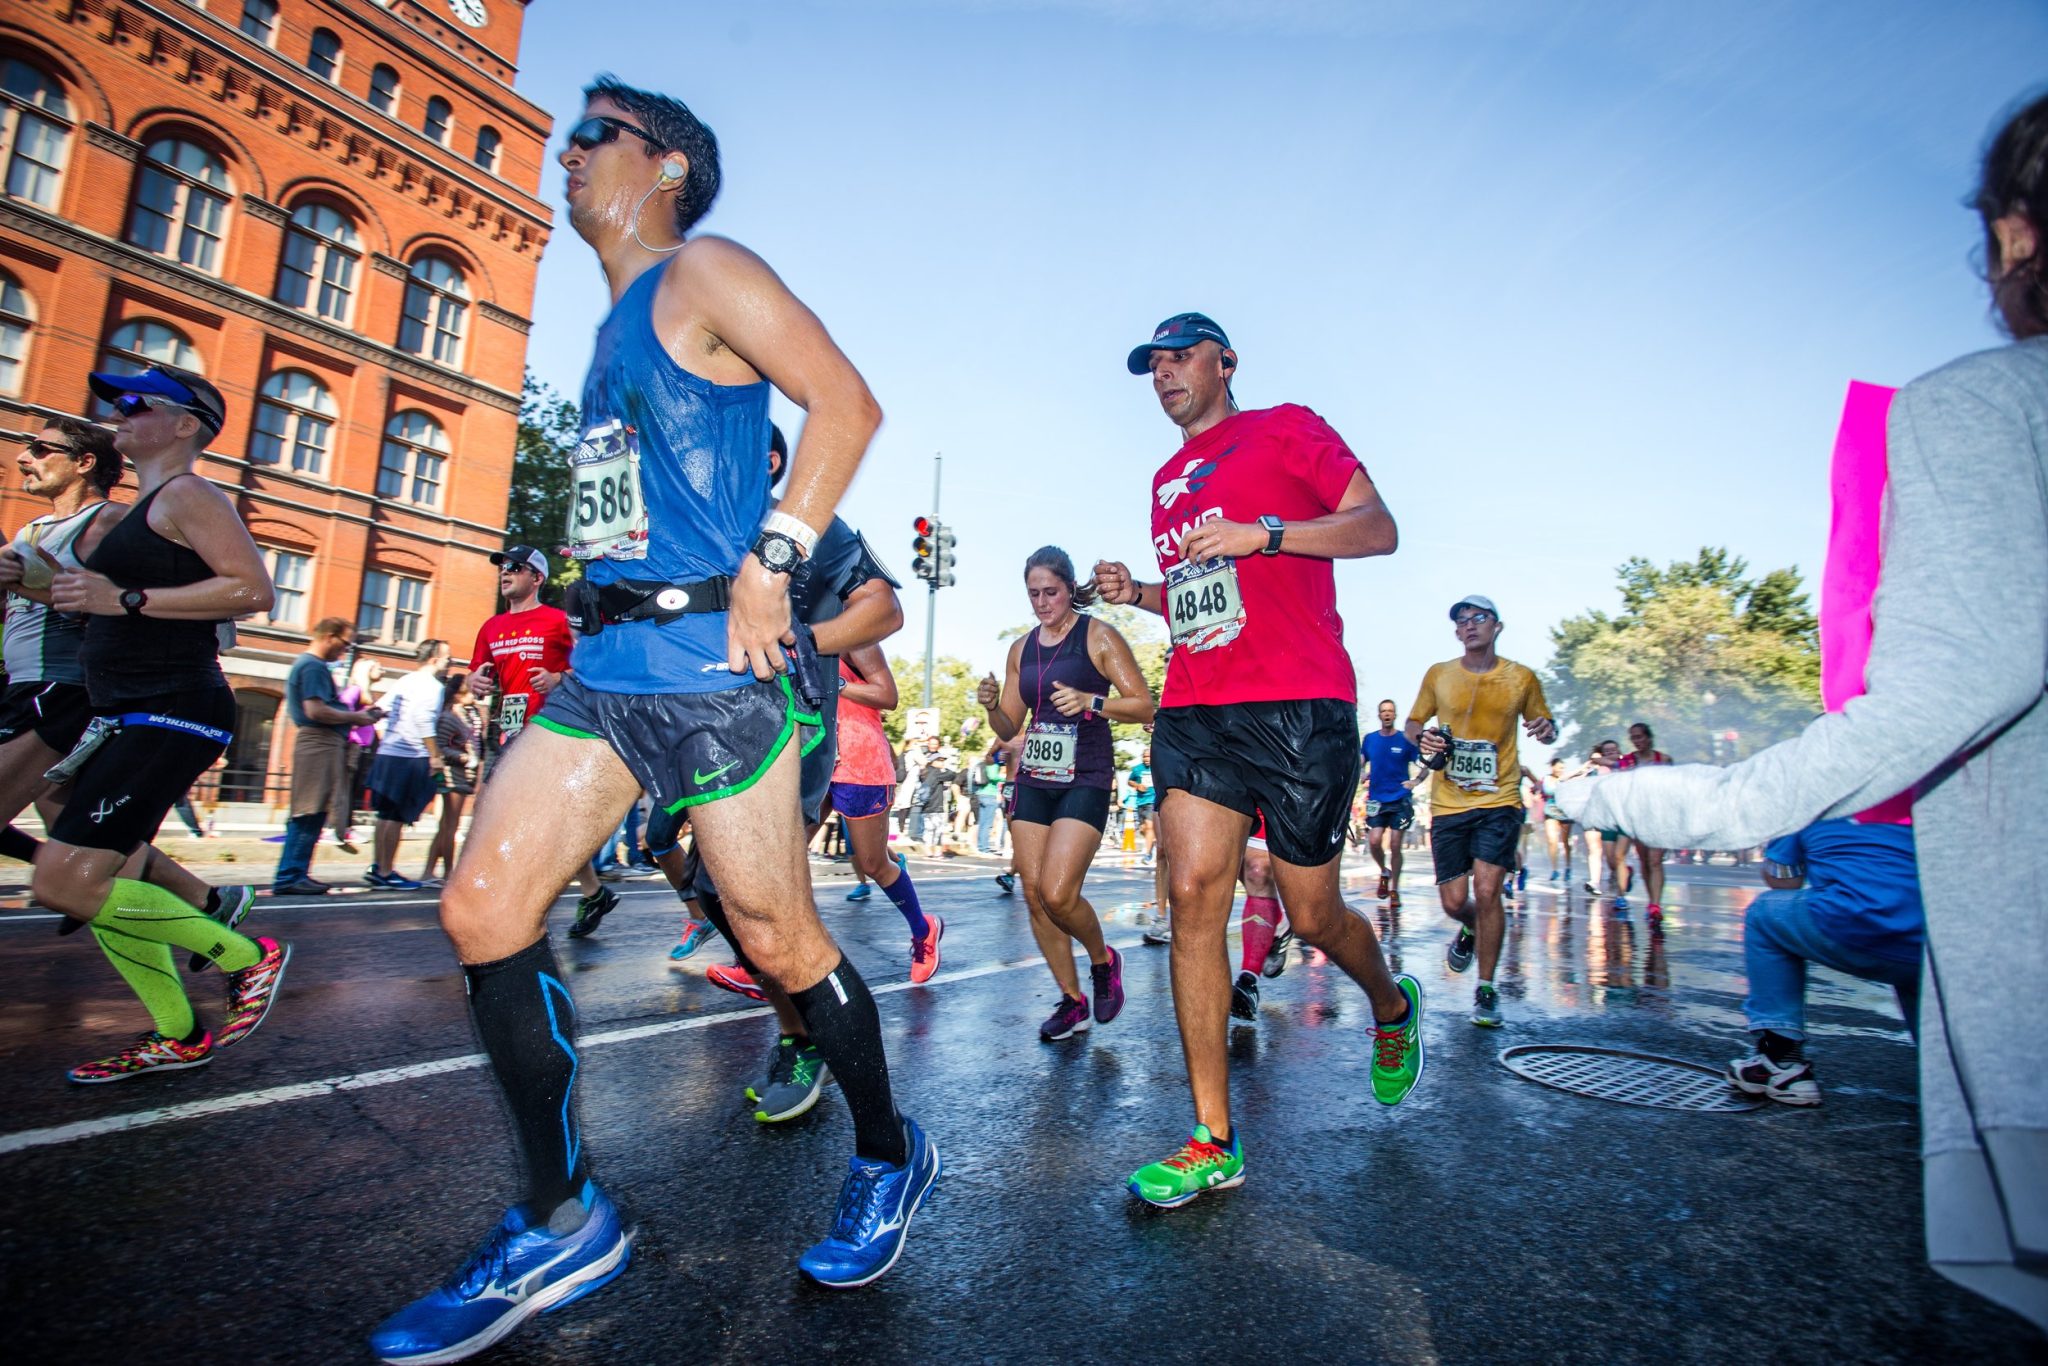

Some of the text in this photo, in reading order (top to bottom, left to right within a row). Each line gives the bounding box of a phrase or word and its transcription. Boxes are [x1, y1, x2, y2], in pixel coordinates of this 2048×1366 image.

[578, 470, 633, 528] 586
[1174, 581, 1227, 624] 4848
[505, 638, 519, 646] RED
[519, 636, 544, 644] CROSS
[148, 715, 208, 735] TRIATHLON
[1026, 739, 1063, 762] 3989
[1450, 755, 1492, 774] 15846
